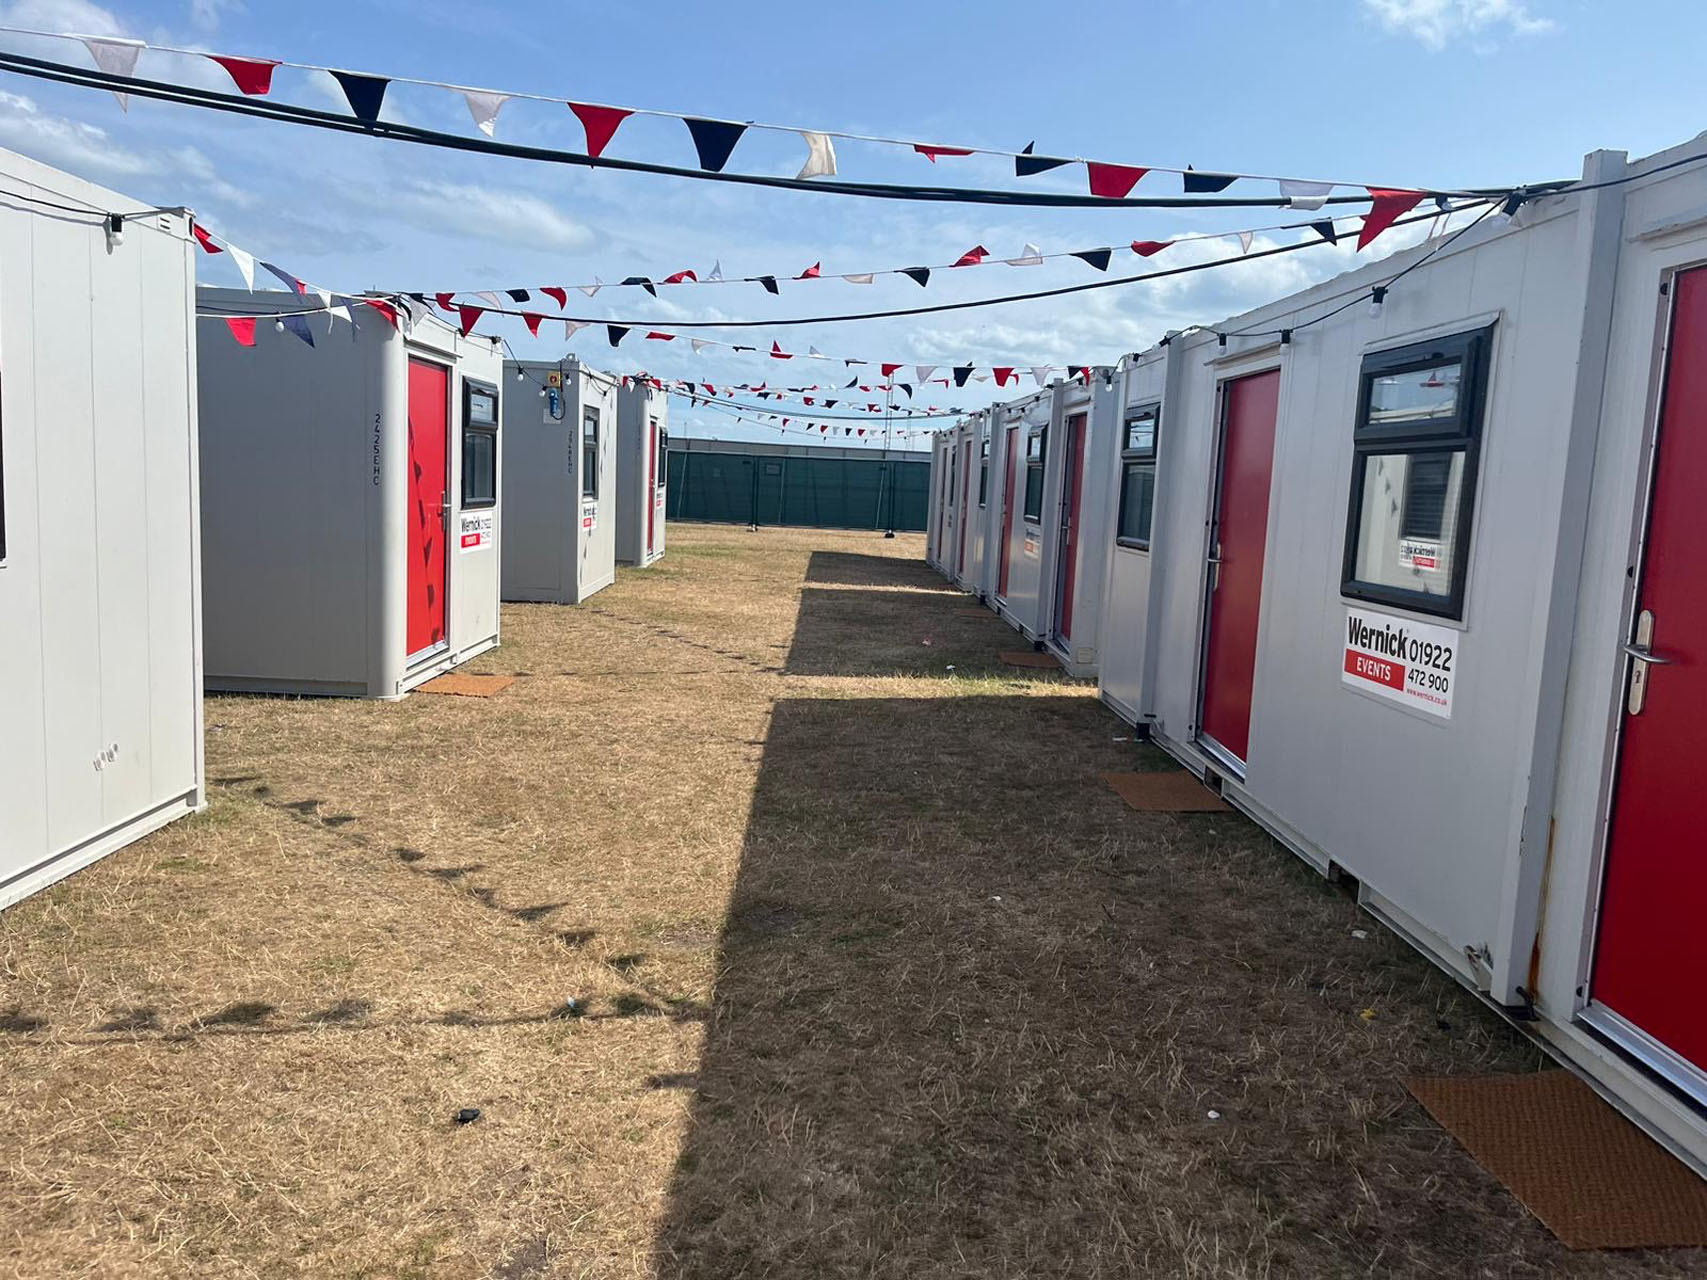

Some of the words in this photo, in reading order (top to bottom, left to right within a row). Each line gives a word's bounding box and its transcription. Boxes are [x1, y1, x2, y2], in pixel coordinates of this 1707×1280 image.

[373, 413, 381, 485] 2425EHC
[1348, 616, 1407, 660] Wernick
[1409, 639, 1452, 672] 01922
[1356, 657, 1391, 681] EVENTS
[1408, 668, 1425, 687] 472
[1428, 673, 1449, 693] 900
